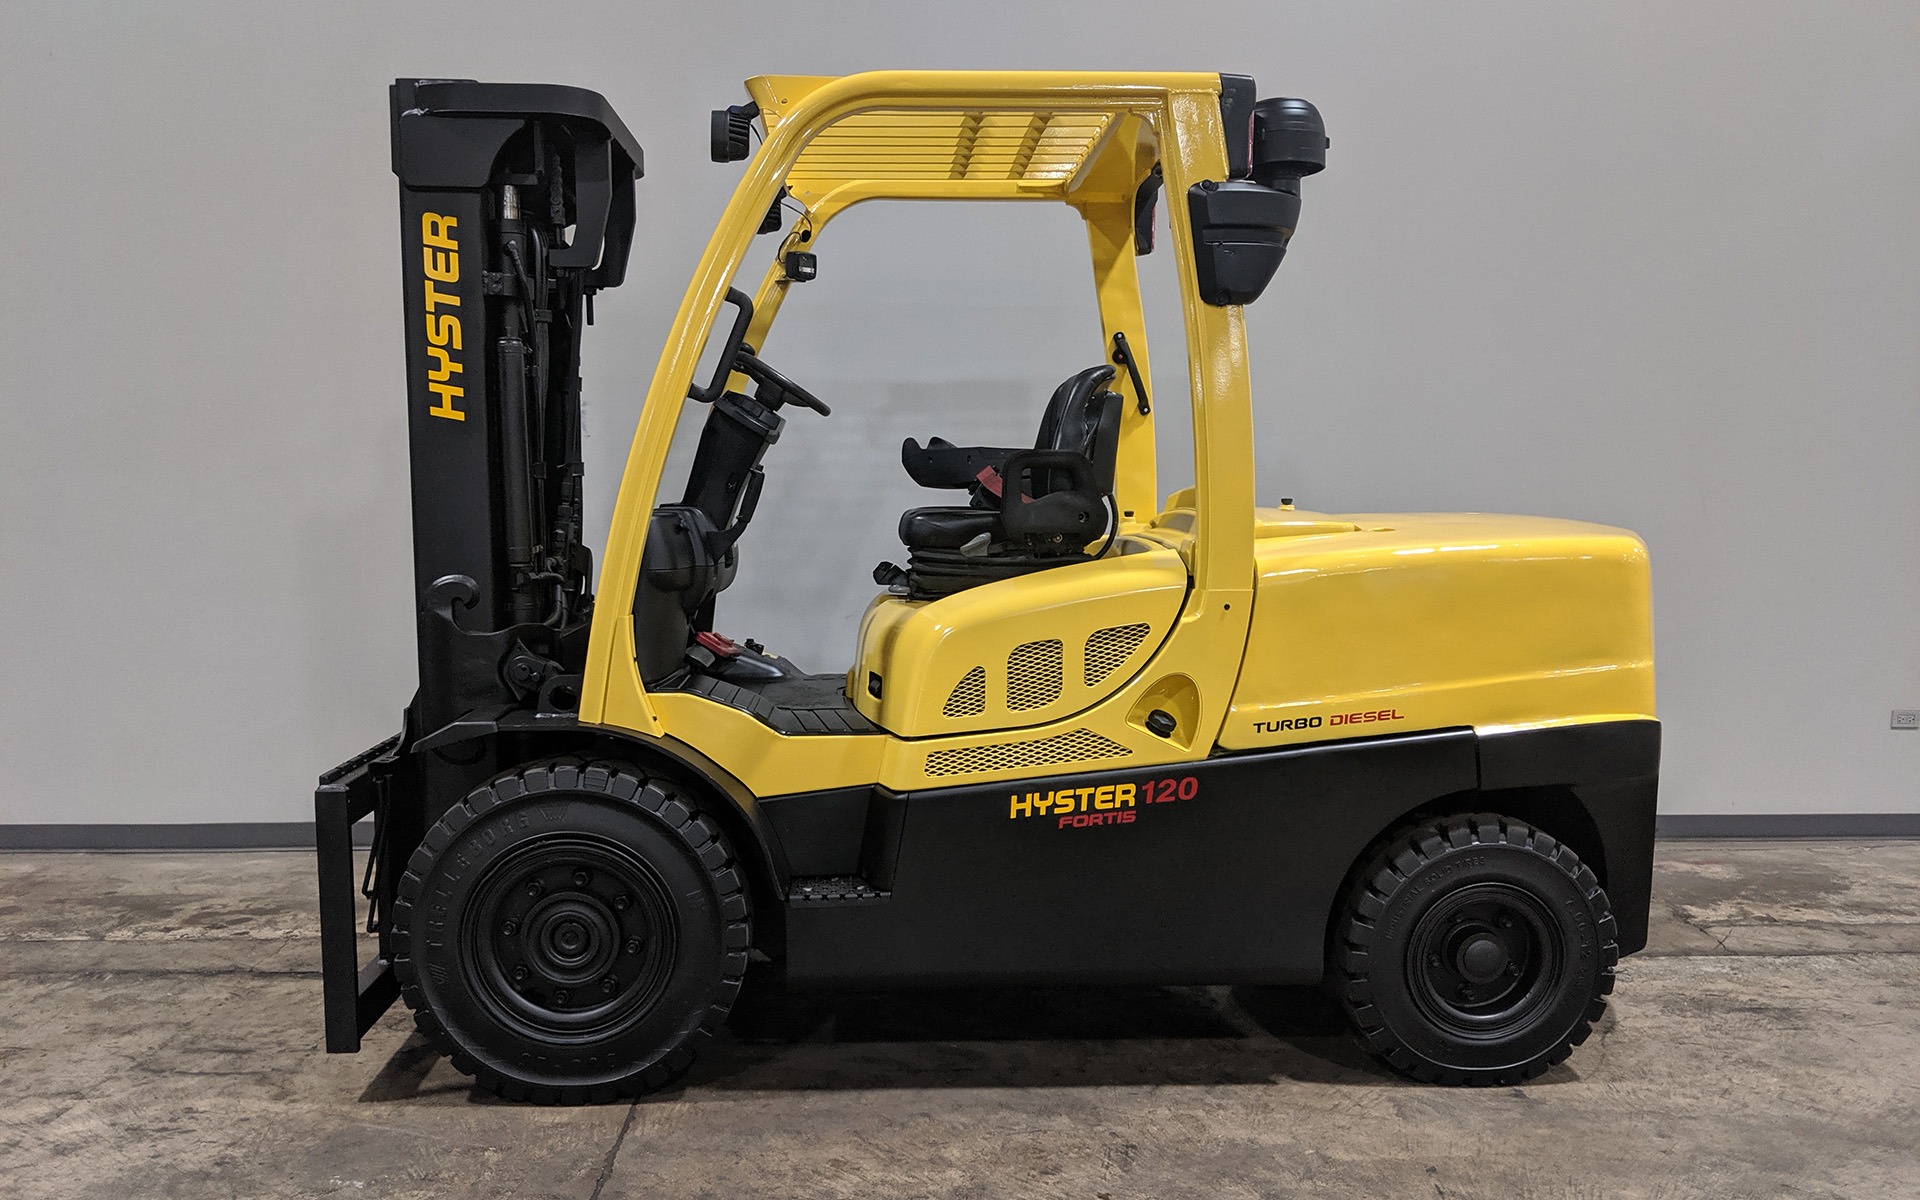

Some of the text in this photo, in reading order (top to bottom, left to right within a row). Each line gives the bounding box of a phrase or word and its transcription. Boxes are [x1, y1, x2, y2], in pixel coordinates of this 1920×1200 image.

[422, 212, 466, 422] HYSTER
[1253, 709, 1405, 734] TURBO DIESEL
[1010, 776, 1199, 819] HYSTER 120
[1058, 810, 1137, 829] FORTIS
